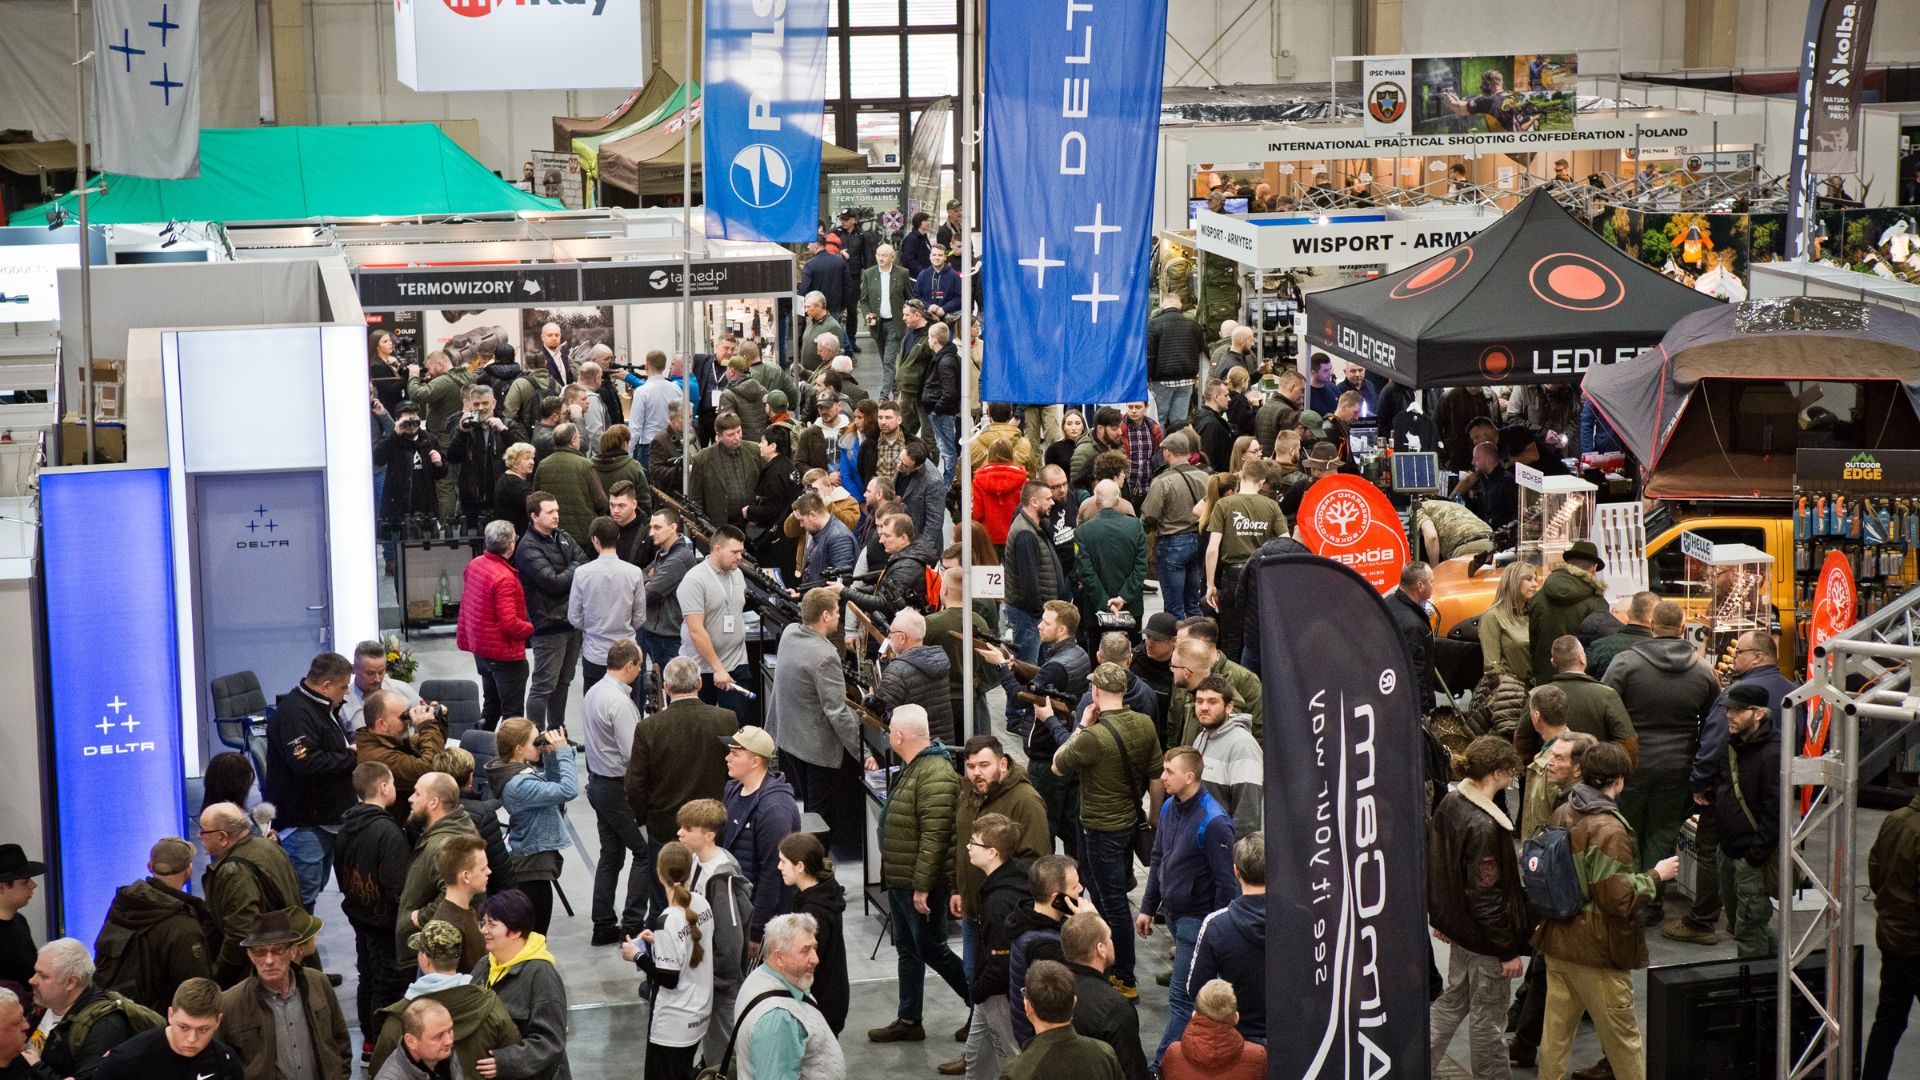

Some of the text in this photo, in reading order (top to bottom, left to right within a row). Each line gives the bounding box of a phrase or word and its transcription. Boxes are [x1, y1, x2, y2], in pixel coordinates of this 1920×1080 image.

[1268, 140, 1370, 152] INTERNATIONAL
[1375, 137, 1444, 148] PRACTICAL
[1448, 134, 1515, 145] SHOOTING
[1519, 130, 1625, 142] CONFEDERATION
[1637, 127, 1688, 138] POLAND
[836, 194, 898, 202] TERYTORIALNEJ
[1201, 224, 1224, 241] WISPORT
[1227, 231, 1253, 251] ARMYTEC
[1292, 234, 1394, 254] WISPORT
[1414, 231, 1482, 249] ARMY
[398, 280, 514, 296] TERMOWIZORY
[1337, 324, 1396, 371] LEDLENSER
[1532, 347, 1654, 374] LEDLE
[1843, 468, 1883, 480] EDGE
[237, 540, 289, 549] DELTA
[1691, 534, 1711, 556] HELLE
[986, 573, 1002, 585] 72
[83, 741, 154, 756] DELTA
